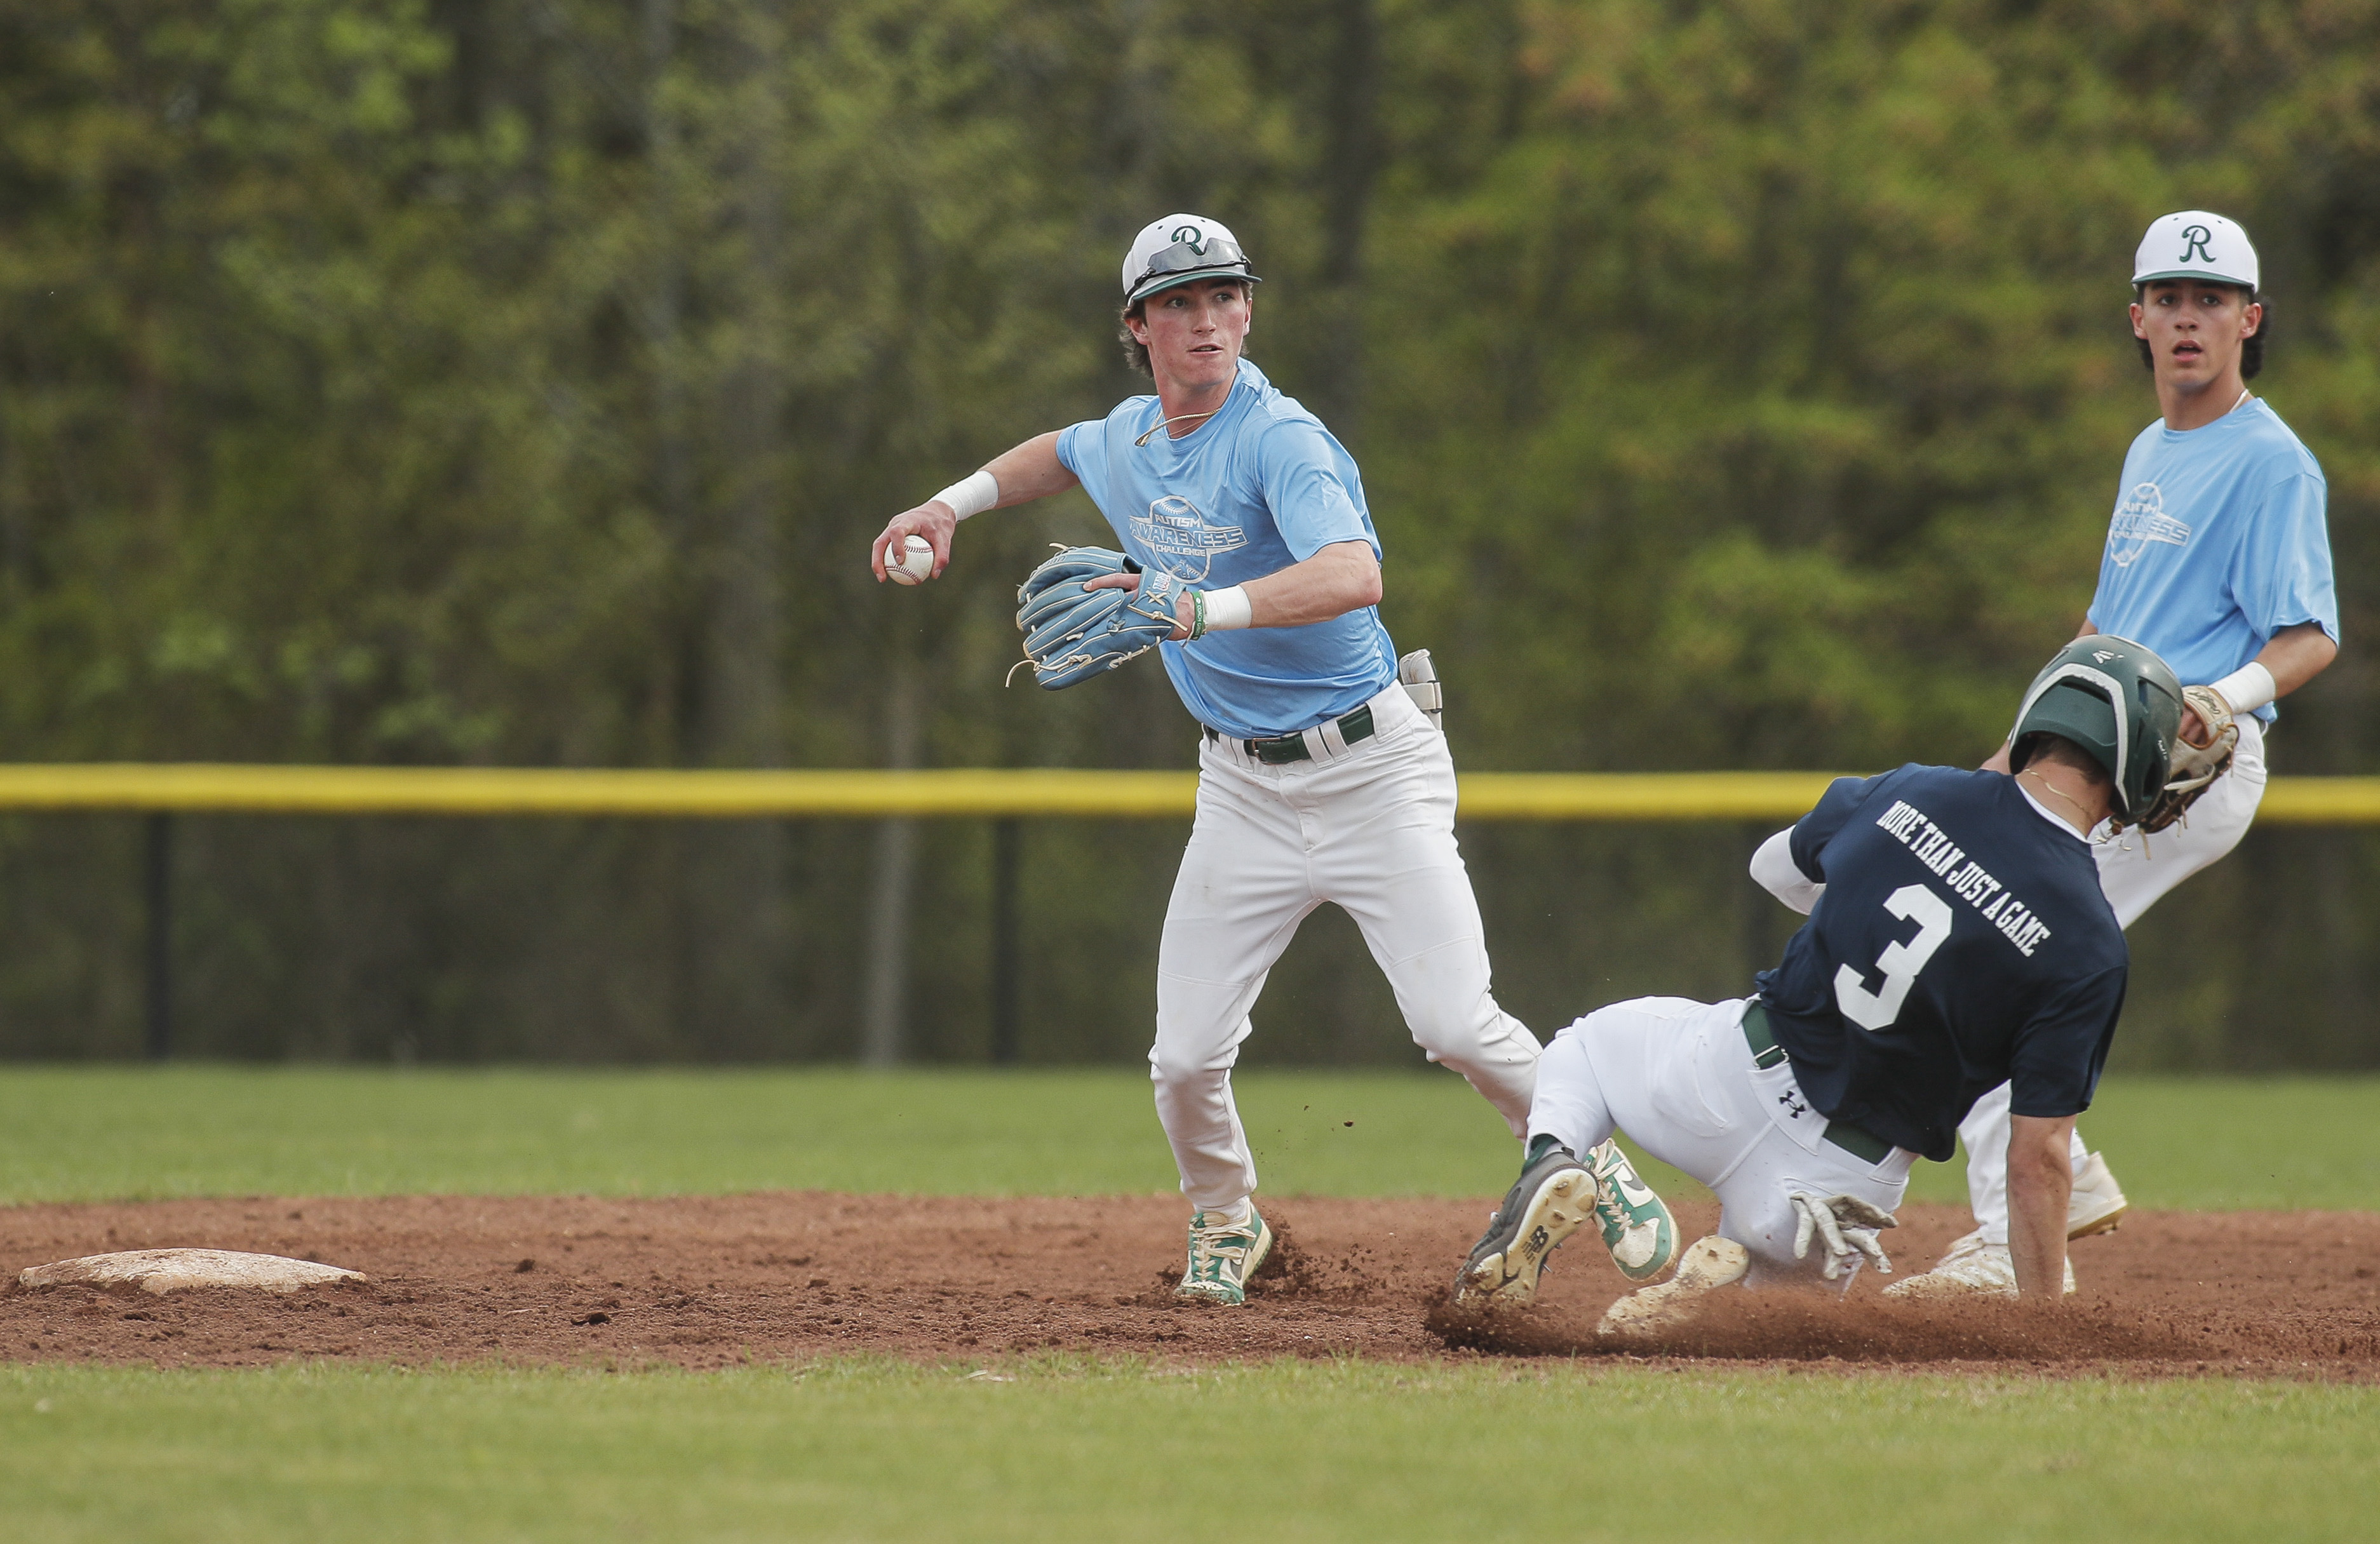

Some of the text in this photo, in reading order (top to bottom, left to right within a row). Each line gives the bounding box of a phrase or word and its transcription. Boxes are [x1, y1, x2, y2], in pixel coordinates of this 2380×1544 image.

[1171, 225, 1205, 255] R
[2179, 225, 2216, 262] R
[1129, 521, 1247, 548] AWARENESS
[1154, 514, 1200, 528] AUTISM
[1155, 544, 1206, 557] CHALLENGE
[1909, 822, 1966, 877] THAN
[1946, 861, 2003, 908] JUST
[1981, 892, 2012, 921] A
[1994, 901, 2052, 957] GAME
[1833, 883, 1954, 1031] 3
